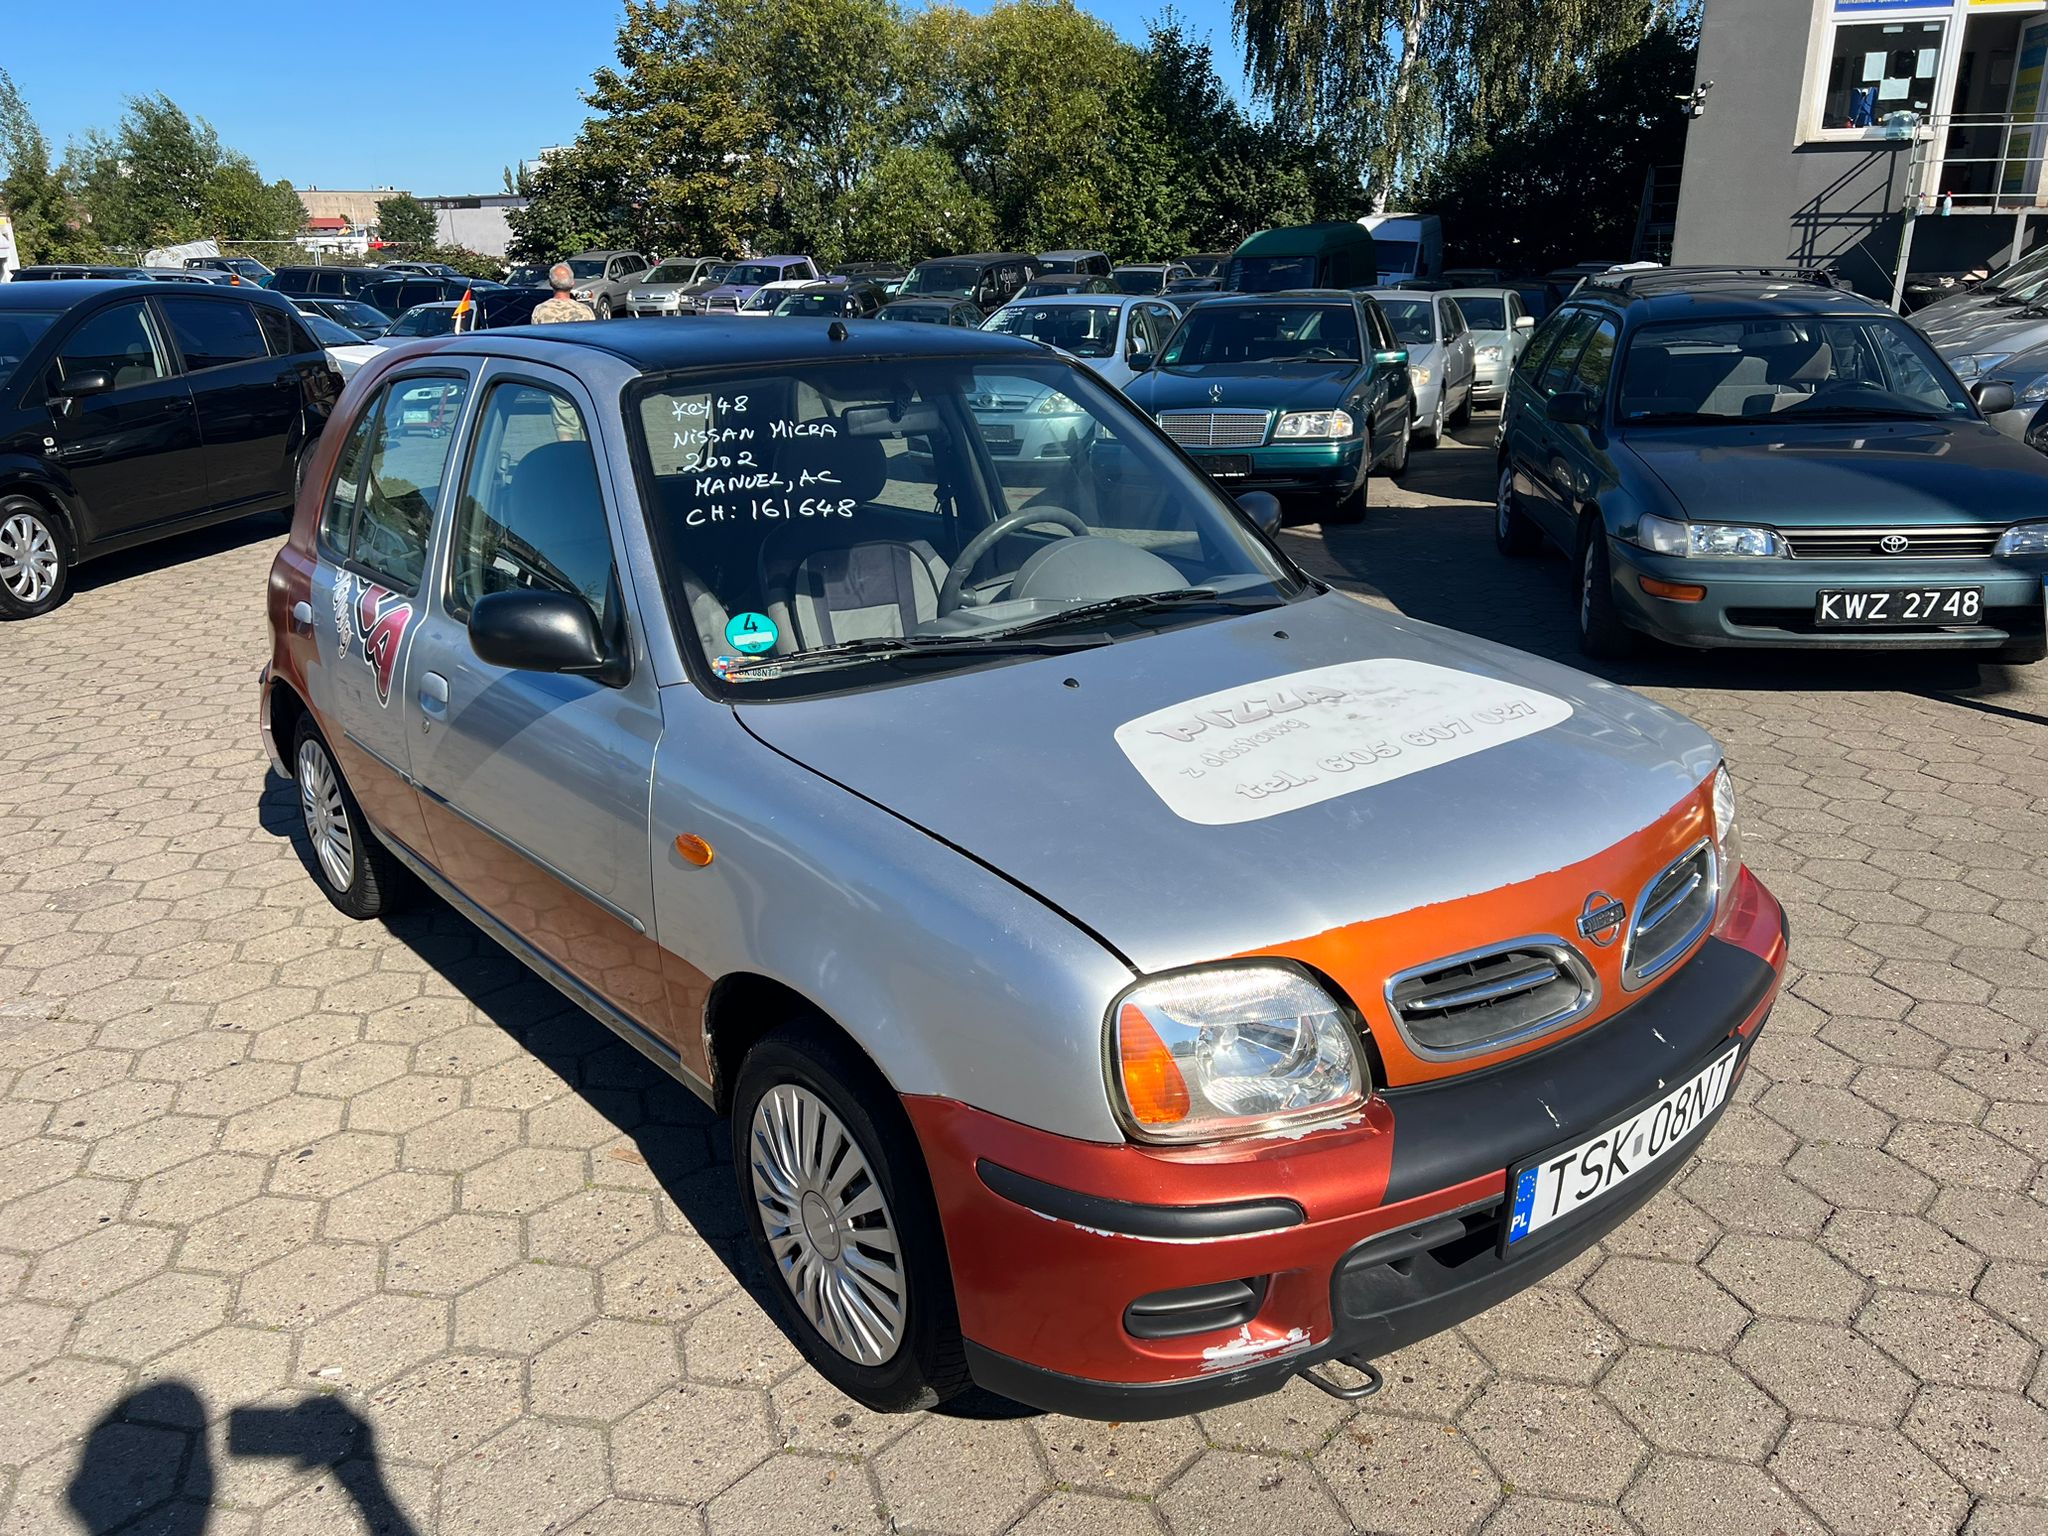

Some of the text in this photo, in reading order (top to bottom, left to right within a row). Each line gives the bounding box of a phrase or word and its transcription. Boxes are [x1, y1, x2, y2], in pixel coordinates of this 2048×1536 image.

[716, 396, 749, 414] 48
[683, 451, 758, 472] 2002
[799, 469, 842, 487] AC
[686, 504, 737, 526] CH:
[1821, 590, 1980, 620] KWZ 2748
[744, 613, 759, 632] 4
[1146, 685, 1347, 743] PIZZA
[1234, 699, 1538, 800] tel. 605 607 027
[1549, 1050, 1735, 1218] TSK 08NT
[1511, 1213, 1528, 1233] PL
